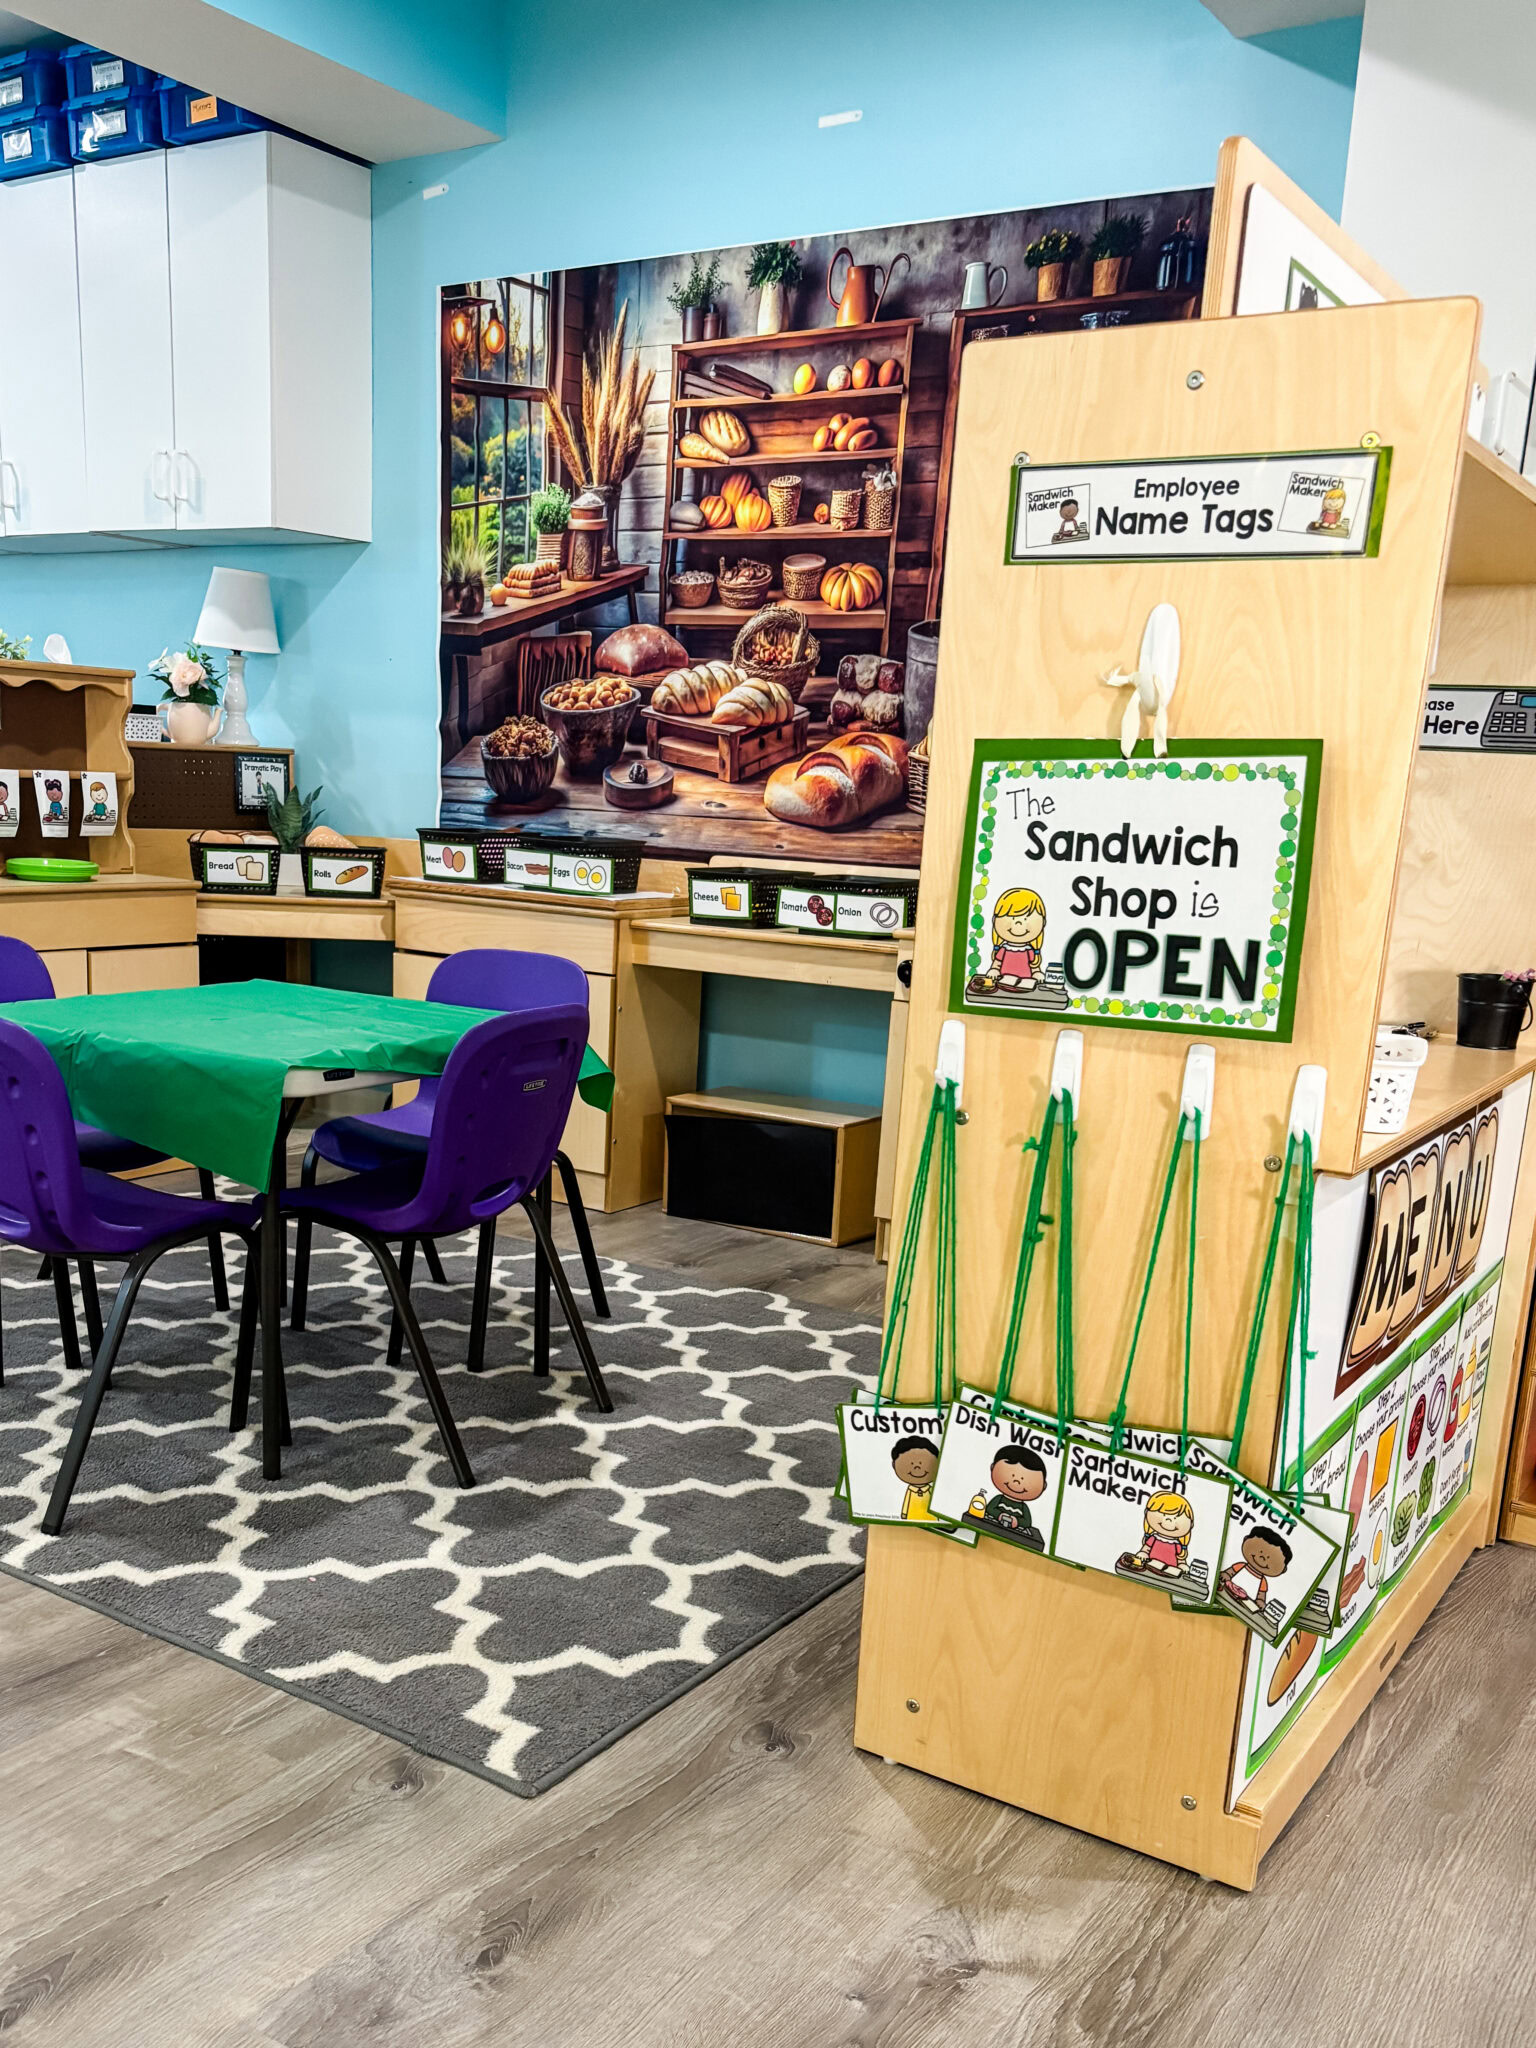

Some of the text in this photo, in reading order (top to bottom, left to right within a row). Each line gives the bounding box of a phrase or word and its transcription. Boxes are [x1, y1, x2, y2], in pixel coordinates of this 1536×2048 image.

[1133, 477, 1240, 501] Employee
[1289, 484, 1328, 499] Maker
[1291, 473, 1345, 490] Sandwich
[1027, 487, 1074, 503] Sandwich
[1027, 499, 1061, 514] Maker
[1095, 503, 1273, 539] Name Tags
[1425, 700, 1455, 711] ase
[1423, 715, 1480, 735] Here
[270, 765, 282, 774] Play
[1005, 787, 1056, 820] The
[1024, 820, 1239, 868] Sandwich
[208, 861, 234, 870] Bread
[425, 854, 442, 864] Meat
[506, 861, 524, 871] Bacon
[313, 869, 332, 878] Rolls
[553, 867, 570, 877] Eggs
[693, 891, 719, 902] Cheese
[781, 901, 808, 913] Tomato
[1069, 875, 1220, 929] Shop is
[838, 906, 862, 917] Onion
[1063, 927, 1262, 1003] OPEN
[1360, 1153, 1490, 1327] MENU
[1377, 1390, 1391, 1413] Step
[850, 1409, 944, 1435] Custom
[955, 1405, 1001, 1438] Dish
[1354, 1422, 1375, 1452] Choose
[1375, 1409, 1389, 1433] your
[1070, 1446, 1187, 1495] Sandwich
[1310, 1459, 1328, 1486] Step
[1327, 1455, 1347, 1489] bread
[1068, 1467, 1152, 1505] Maker
[1368, 1491, 1386, 1519] cheese
[1286, 1681, 1297, 1707] roll
